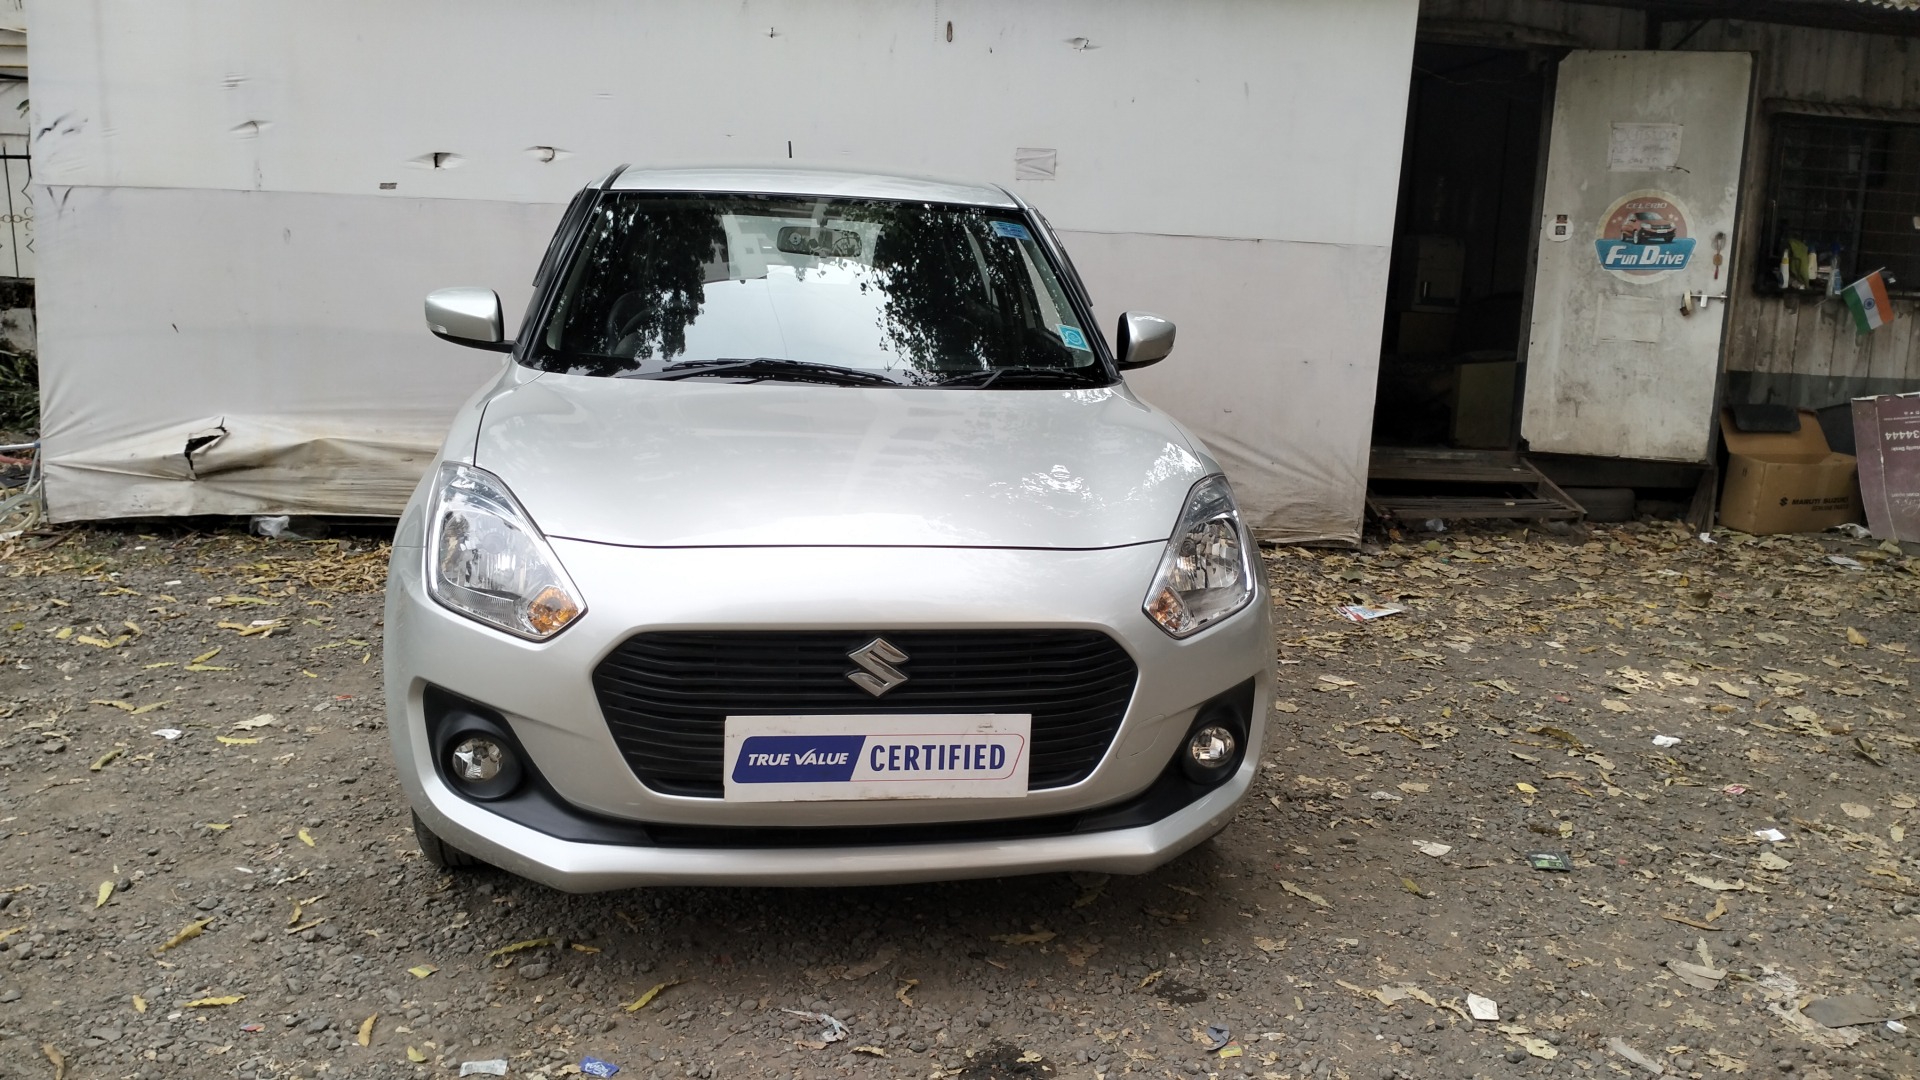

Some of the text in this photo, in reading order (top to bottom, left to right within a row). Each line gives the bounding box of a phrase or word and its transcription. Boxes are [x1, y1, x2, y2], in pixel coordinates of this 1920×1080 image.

[1605, 245, 1684, 265] Fun Drive
[1823, 496, 1849, 504] SUZUKI
[748, 744, 1006, 772] TRUE VALUE CERTIFIED
